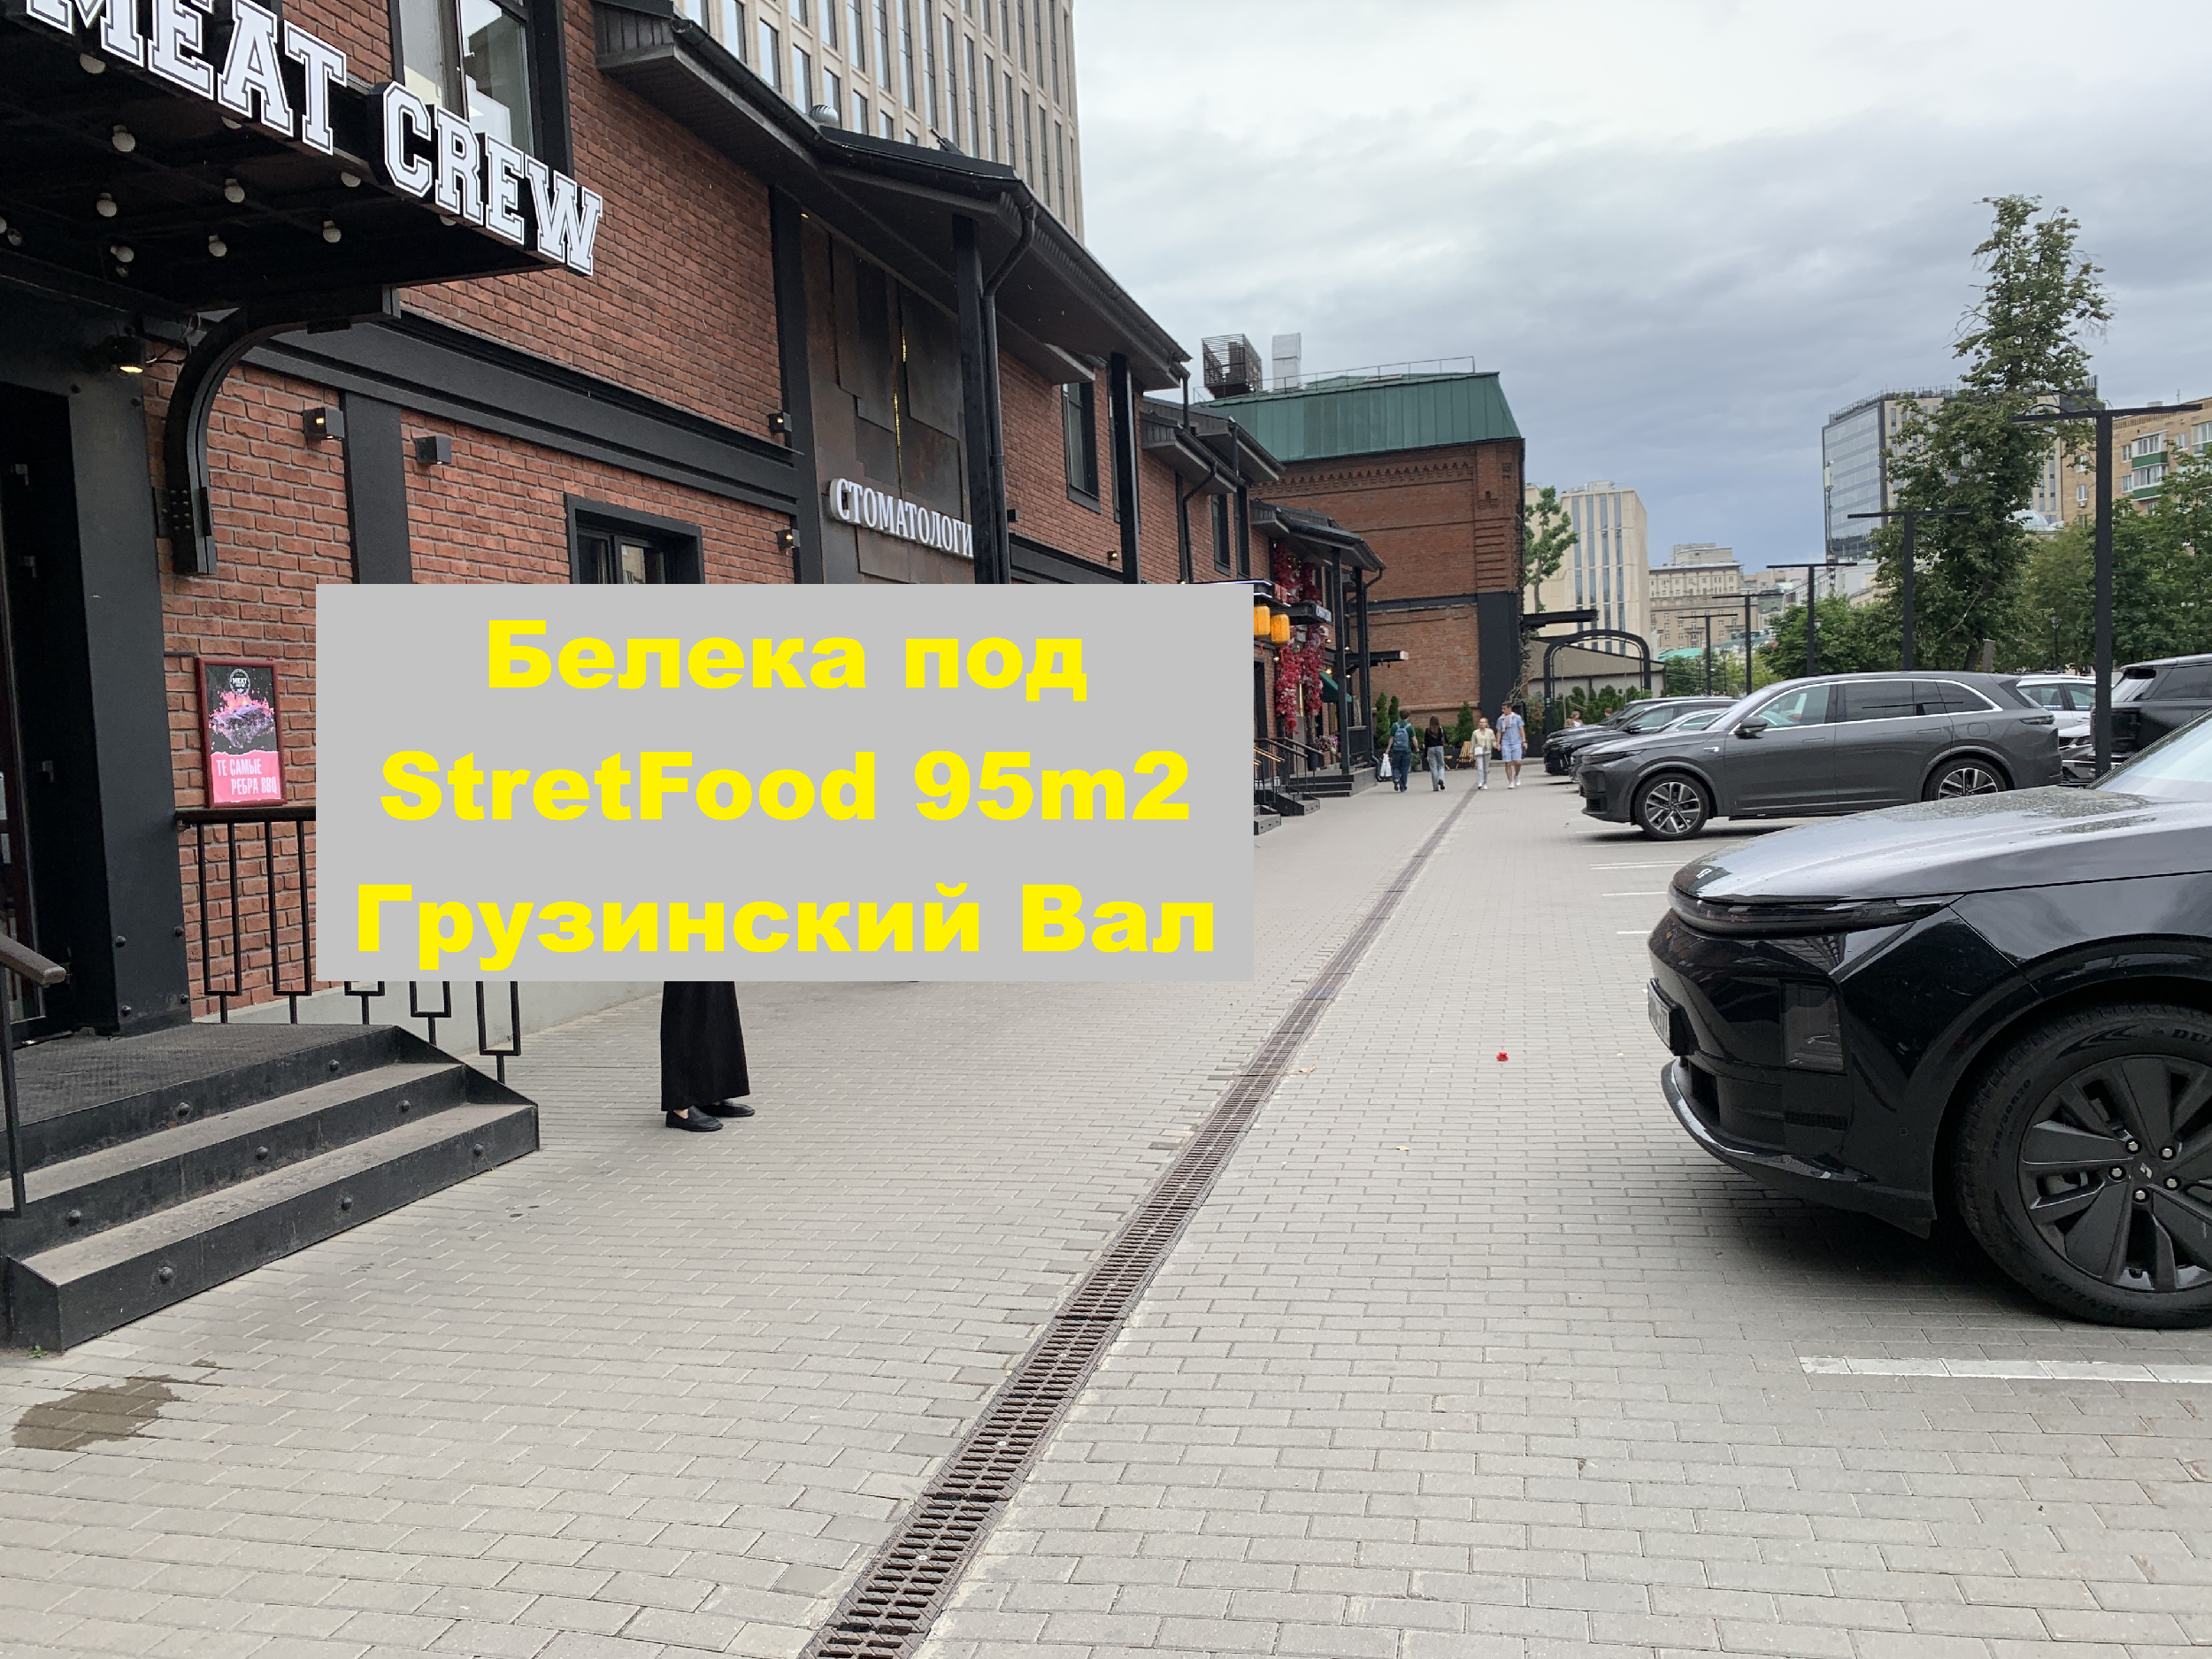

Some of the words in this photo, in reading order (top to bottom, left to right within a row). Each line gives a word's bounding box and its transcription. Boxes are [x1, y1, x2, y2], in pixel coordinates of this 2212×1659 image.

[382, 81, 603, 275] CREW
[216, 759, 227, 776] ТЕ
[230, 758, 262, 776] САМЫЕ
[231, 778, 259, 795] РЕБРА
[261, 776, 277, 794] BBQ
